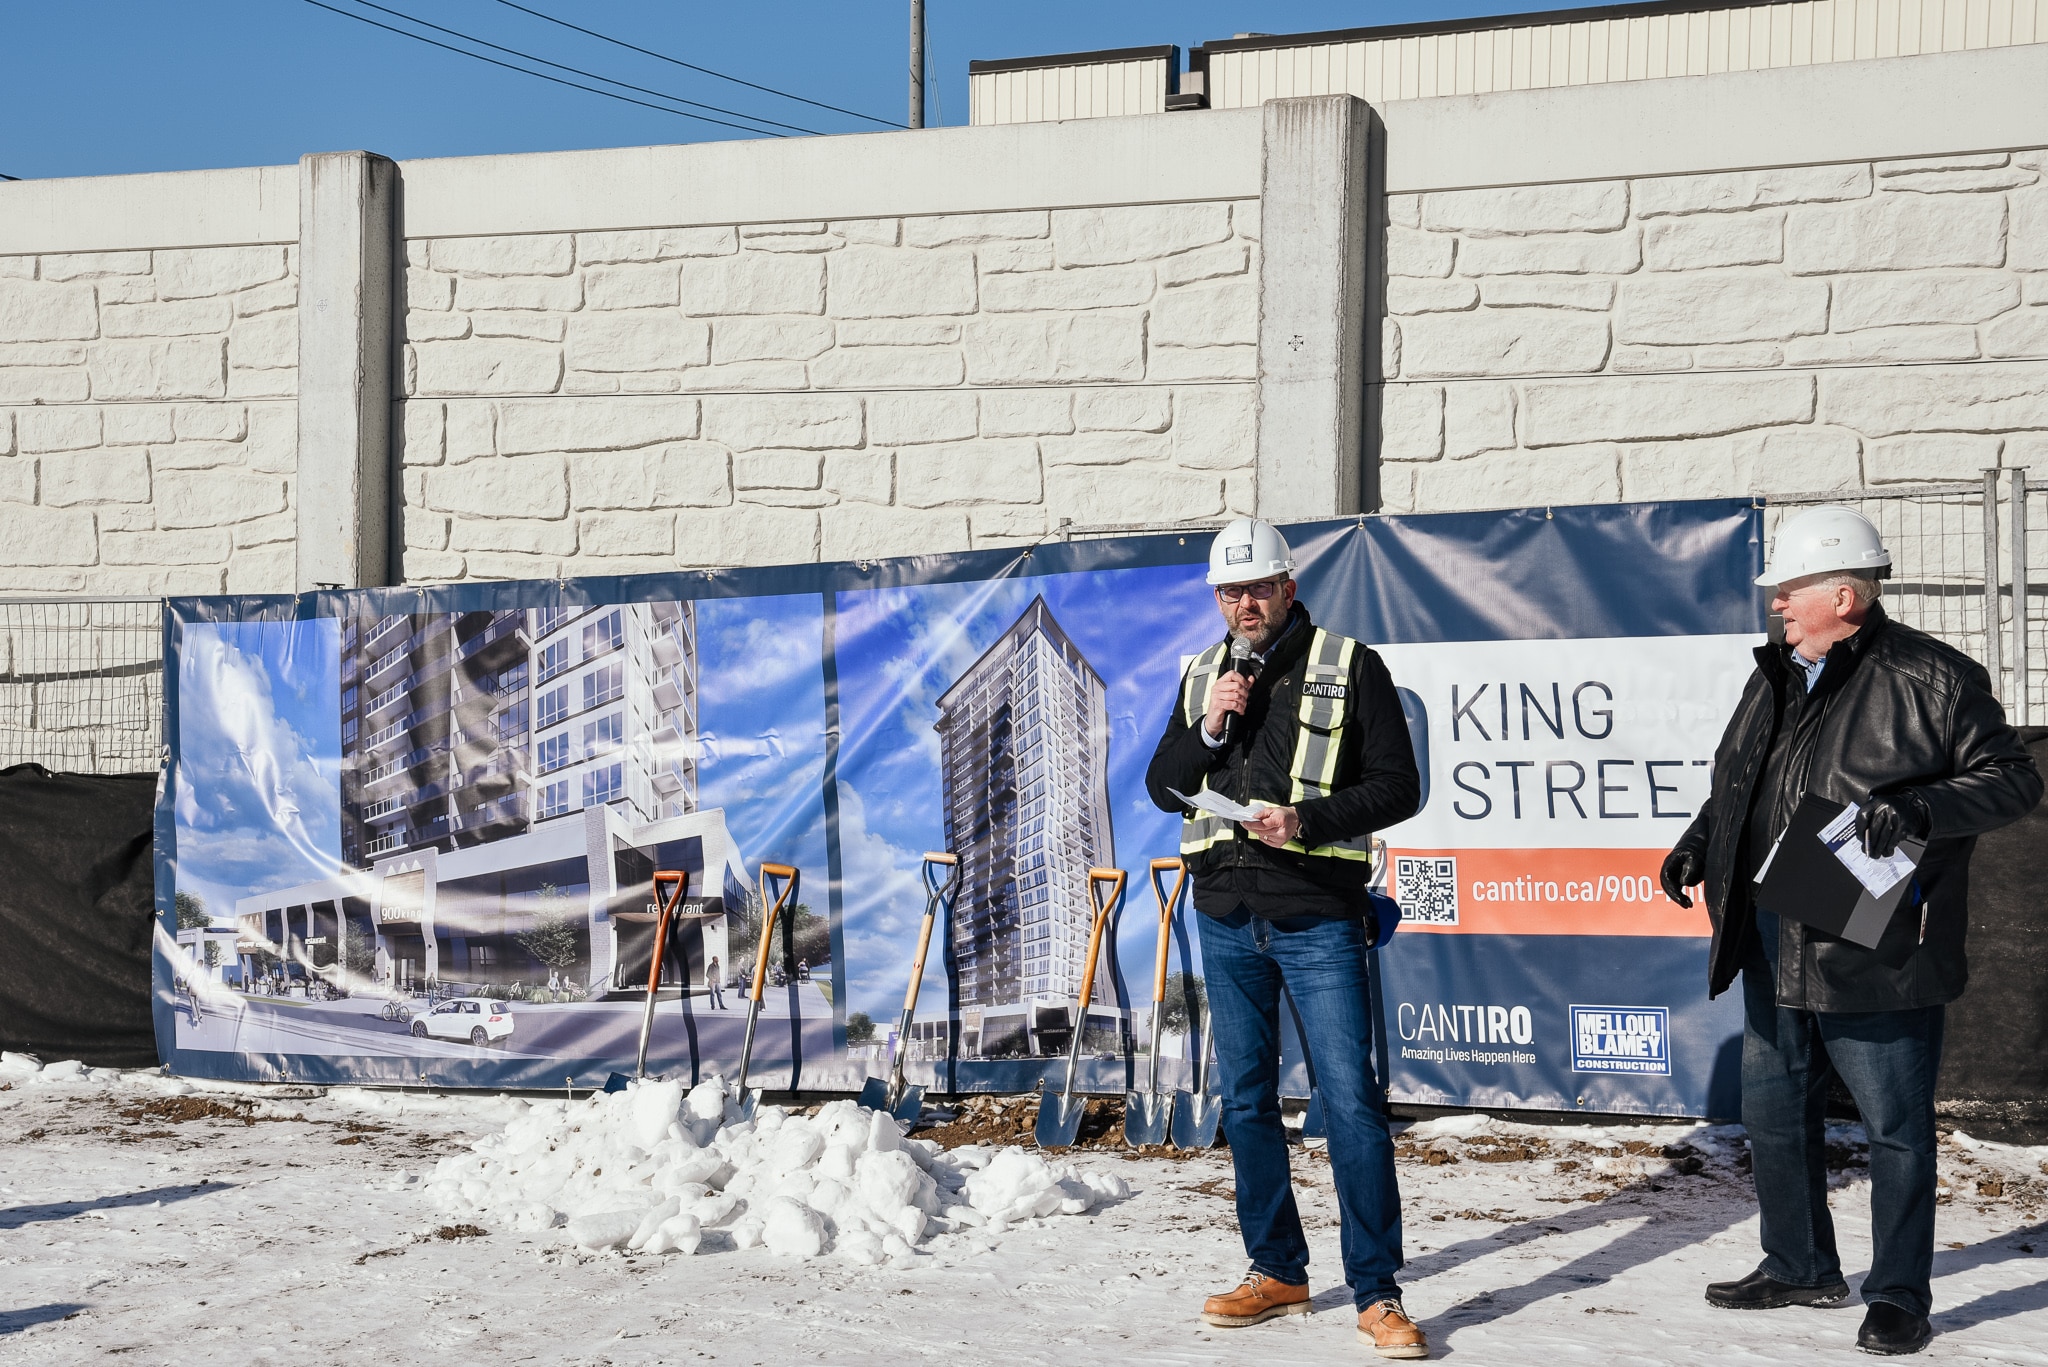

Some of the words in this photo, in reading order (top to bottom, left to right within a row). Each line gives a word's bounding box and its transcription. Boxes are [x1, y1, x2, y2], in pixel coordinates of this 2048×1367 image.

[1302, 683, 1345, 698] CANTIRO
[1451, 680, 1613, 742] KING
[1578, 1013, 1660, 1036] MELLOUL
[1401, 1046, 1443, 1064] Amazing
[1445, 1047, 1470, 1062] Lives
[1471, 1049, 1511, 1066] Happen
[1512, 1051, 1536, 1064] Here
[1579, 1034, 1660, 1057] BLAMEY
[1577, 1059, 1666, 1072] CONSTRUCTION
